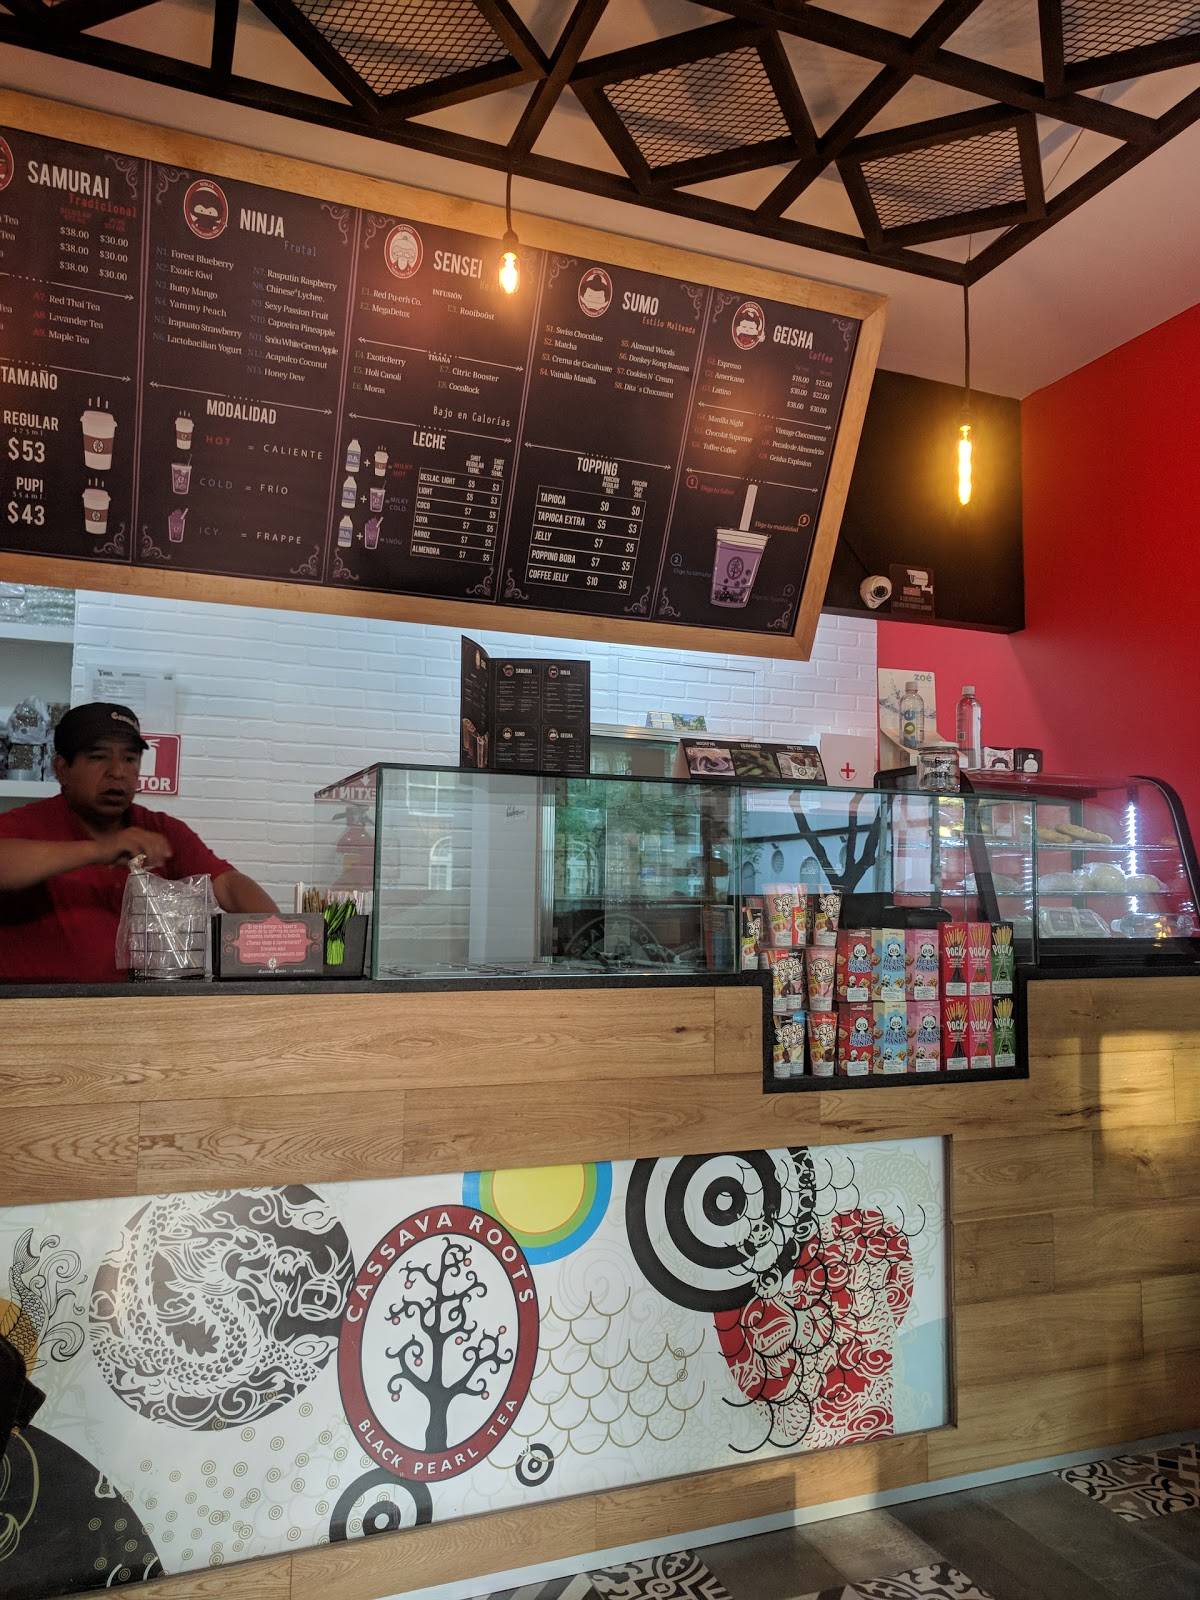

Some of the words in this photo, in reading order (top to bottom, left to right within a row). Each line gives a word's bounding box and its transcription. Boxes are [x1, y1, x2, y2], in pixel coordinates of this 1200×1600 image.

[28, 160, 109, 199] SAMURAI
[69, 193, 136, 217] Tradicional
[240, 209, 284, 238] NINJA
[60, 226, 89, 239] $38.00
[100, 234, 128, 247] $30.00
[60, 242, 88, 255] $38.00
[99, 250, 128, 263] $30.00
[284, 241, 316, 256] Frutal
[171, 249, 194, 261] Forest
[196, 254, 234, 270] Blueberry
[434, 250, 483, 279] SENSEI
[59, 261, 88, 273] $38.00
[99, 268, 127, 281] $30.00
[170, 266, 194, 278] Exotic
[195, 270, 213, 281] Kiwi
[267, 269, 299, 282] Rasputin
[300, 275, 337, 291] Raspberry
[192, 287, 217, 299] Mango
[373, 289, 386, 300] Red
[49, 295, 65, 305] Red
[67, 298, 85, 310] Thai
[86, 301, 100, 311] Tea
[170, 299, 201, 314] Yammy
[203, 304, 227, 318] Peach
[265, 301, 282, 313] Sexy
[284, 304, 310, 317] Passion
[311, 310, 328, 320] Fruit
[622, 291, 659, 316] SUMO
[49, 313, 88, 327] Lavander
[89, 319, 103, 329] Tea
[267, 318, 300, 331] Capoeira
[301, 324, 336, 337] Pineapple
[49, 330, 74, 343] Maple
[76, 335, 90, 344] Tea
[201, 324, 242, 339] Strawberry
[556, 327, 573, 336] Swiss
[574, 329, 603, 343] Chocolate
[773, 325, 814, 350] GEISHA
[218, 342, 242, 354] Yogurt
[555, 340, 577, 351] Matcha
[631, 341, 654, 353] Almond
[265, 351, 297, 365] Acapulco
[299, 357, 327, 368] Coconut
[552, 354, 572, 366] Crema
[573, 359, 581, 367] de
[629, 354, 651, 366] Donkey
[652, 358, 666, 369] Kong
[808, 351, 833, 364] Coffee
[1, 366, 58, 390] TAMAÑO
[265, 368, 287, 381] Honey
[289, 372, 305, 382] Dew
[714, 372, 745, 384] Americano
[4, 410, 58, 431] REGULAR
[207, 399, 277, 424] MODALIDAD
[433, 405, 453, 418] Bajo
[457, 412, 467, 420] en
[8, 437, 45, 462] $53
[205, 435, 231, 445] HOT
[263, 444, 323, 460] CALIENTE
[412, 431, 447, 450] LECHE
[577, 456, 618, 476] TOPPING
[16, 477, 43, 492] PUPI
[200, 478, 233, 489] COLD
[260, 484, 289, 495] FRIO
[7, 501, 45, 526] $43
[540, 492, 566, 506] TAPIOCA
[600, 501, 609, 512] $0
[631, 505, 640, 516] $0
[538, 512, 563, 524] TAPIOCA
[564, 516, 586, 527] EXTRA
[597, 520, 606, 530] $5
[628, 524, 638, 534] $3
[256, 531, 302, 544] FRAPPE
[534, 531, 552, 541] JELLY
[594, 538, 604, 548] $7
[625, 543, 635, 553] $5
[531, 549, 558, 562] POPPING
[559, 553, 576, 564] BOBA
[590, 557, 600, 568] $7
[621, 561, 631, 572] $5
[529, 569, 551, 581] COFFEE
[552, 572, 569, 582] JELLY
[586, 576, 599, 586] $10
[618, 579, 628, 590] $8
[346, 1211, 453, 1324] CASSAVA
[468, 1214, 534, 1303] ROOTS
[357, 1419, 403, 1469] BLACK
[414, 1447, 478, 1475] PEARL
[487, 1399, 517, 1438] TEA
